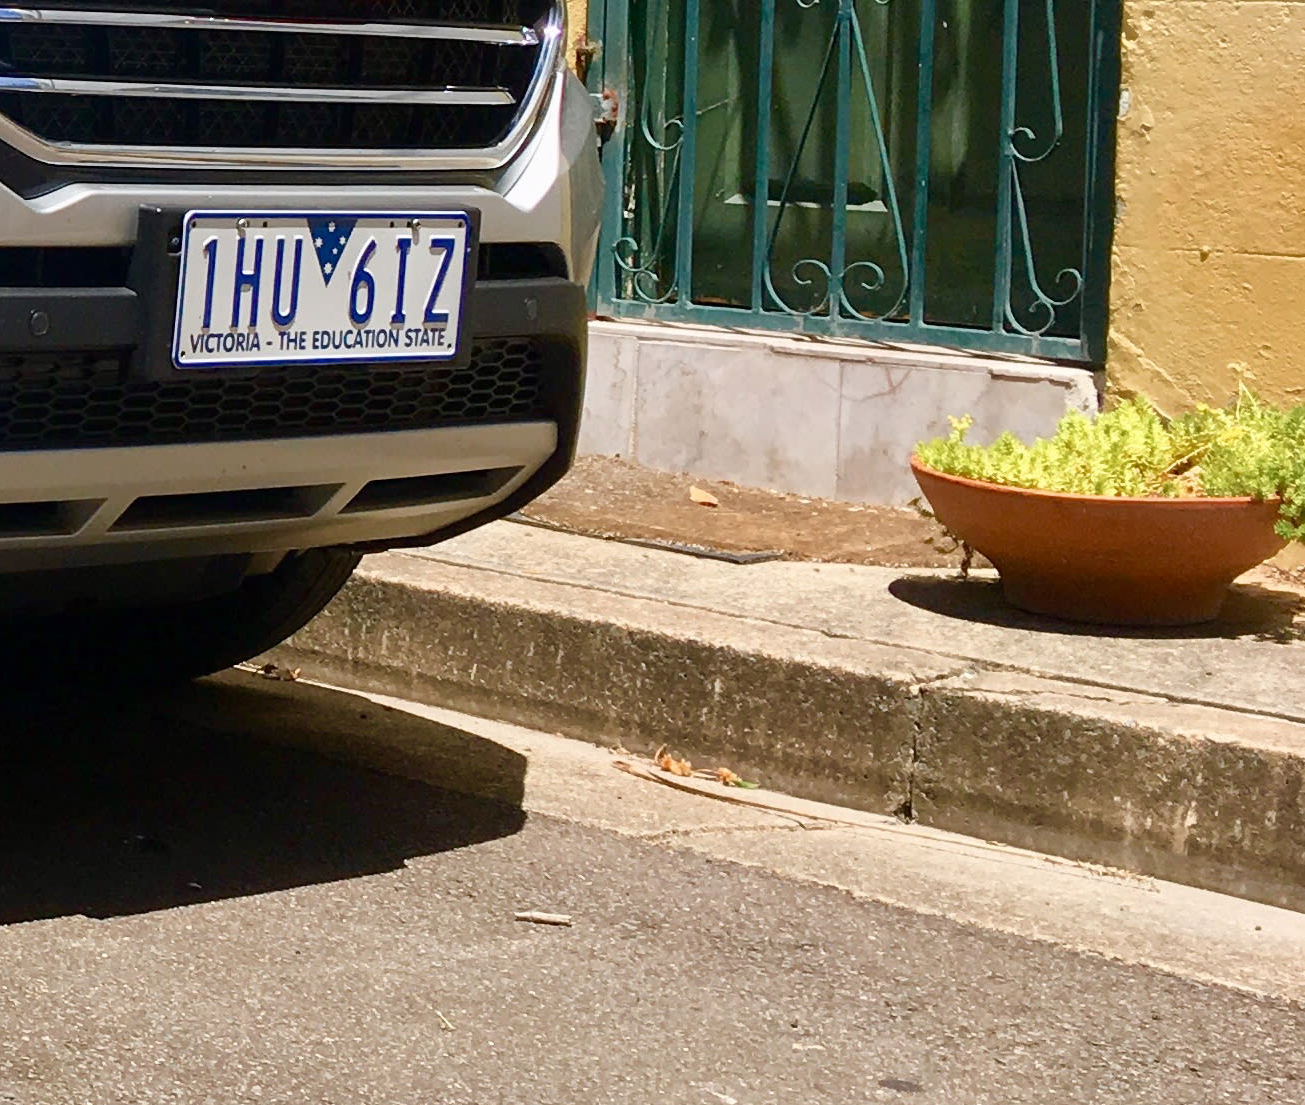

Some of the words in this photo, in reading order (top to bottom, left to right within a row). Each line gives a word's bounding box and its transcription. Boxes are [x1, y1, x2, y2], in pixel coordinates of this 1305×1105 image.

[202, 234, 304, 329] 1HU
[348, 234, 456, 326] 6IZ
[190, 332, 261, 353] VICTORIA
[278, 331, 307, 351] THE
[312, 329, 400, 350] EDUCATION
[404, 327, 445, 348] STATE
